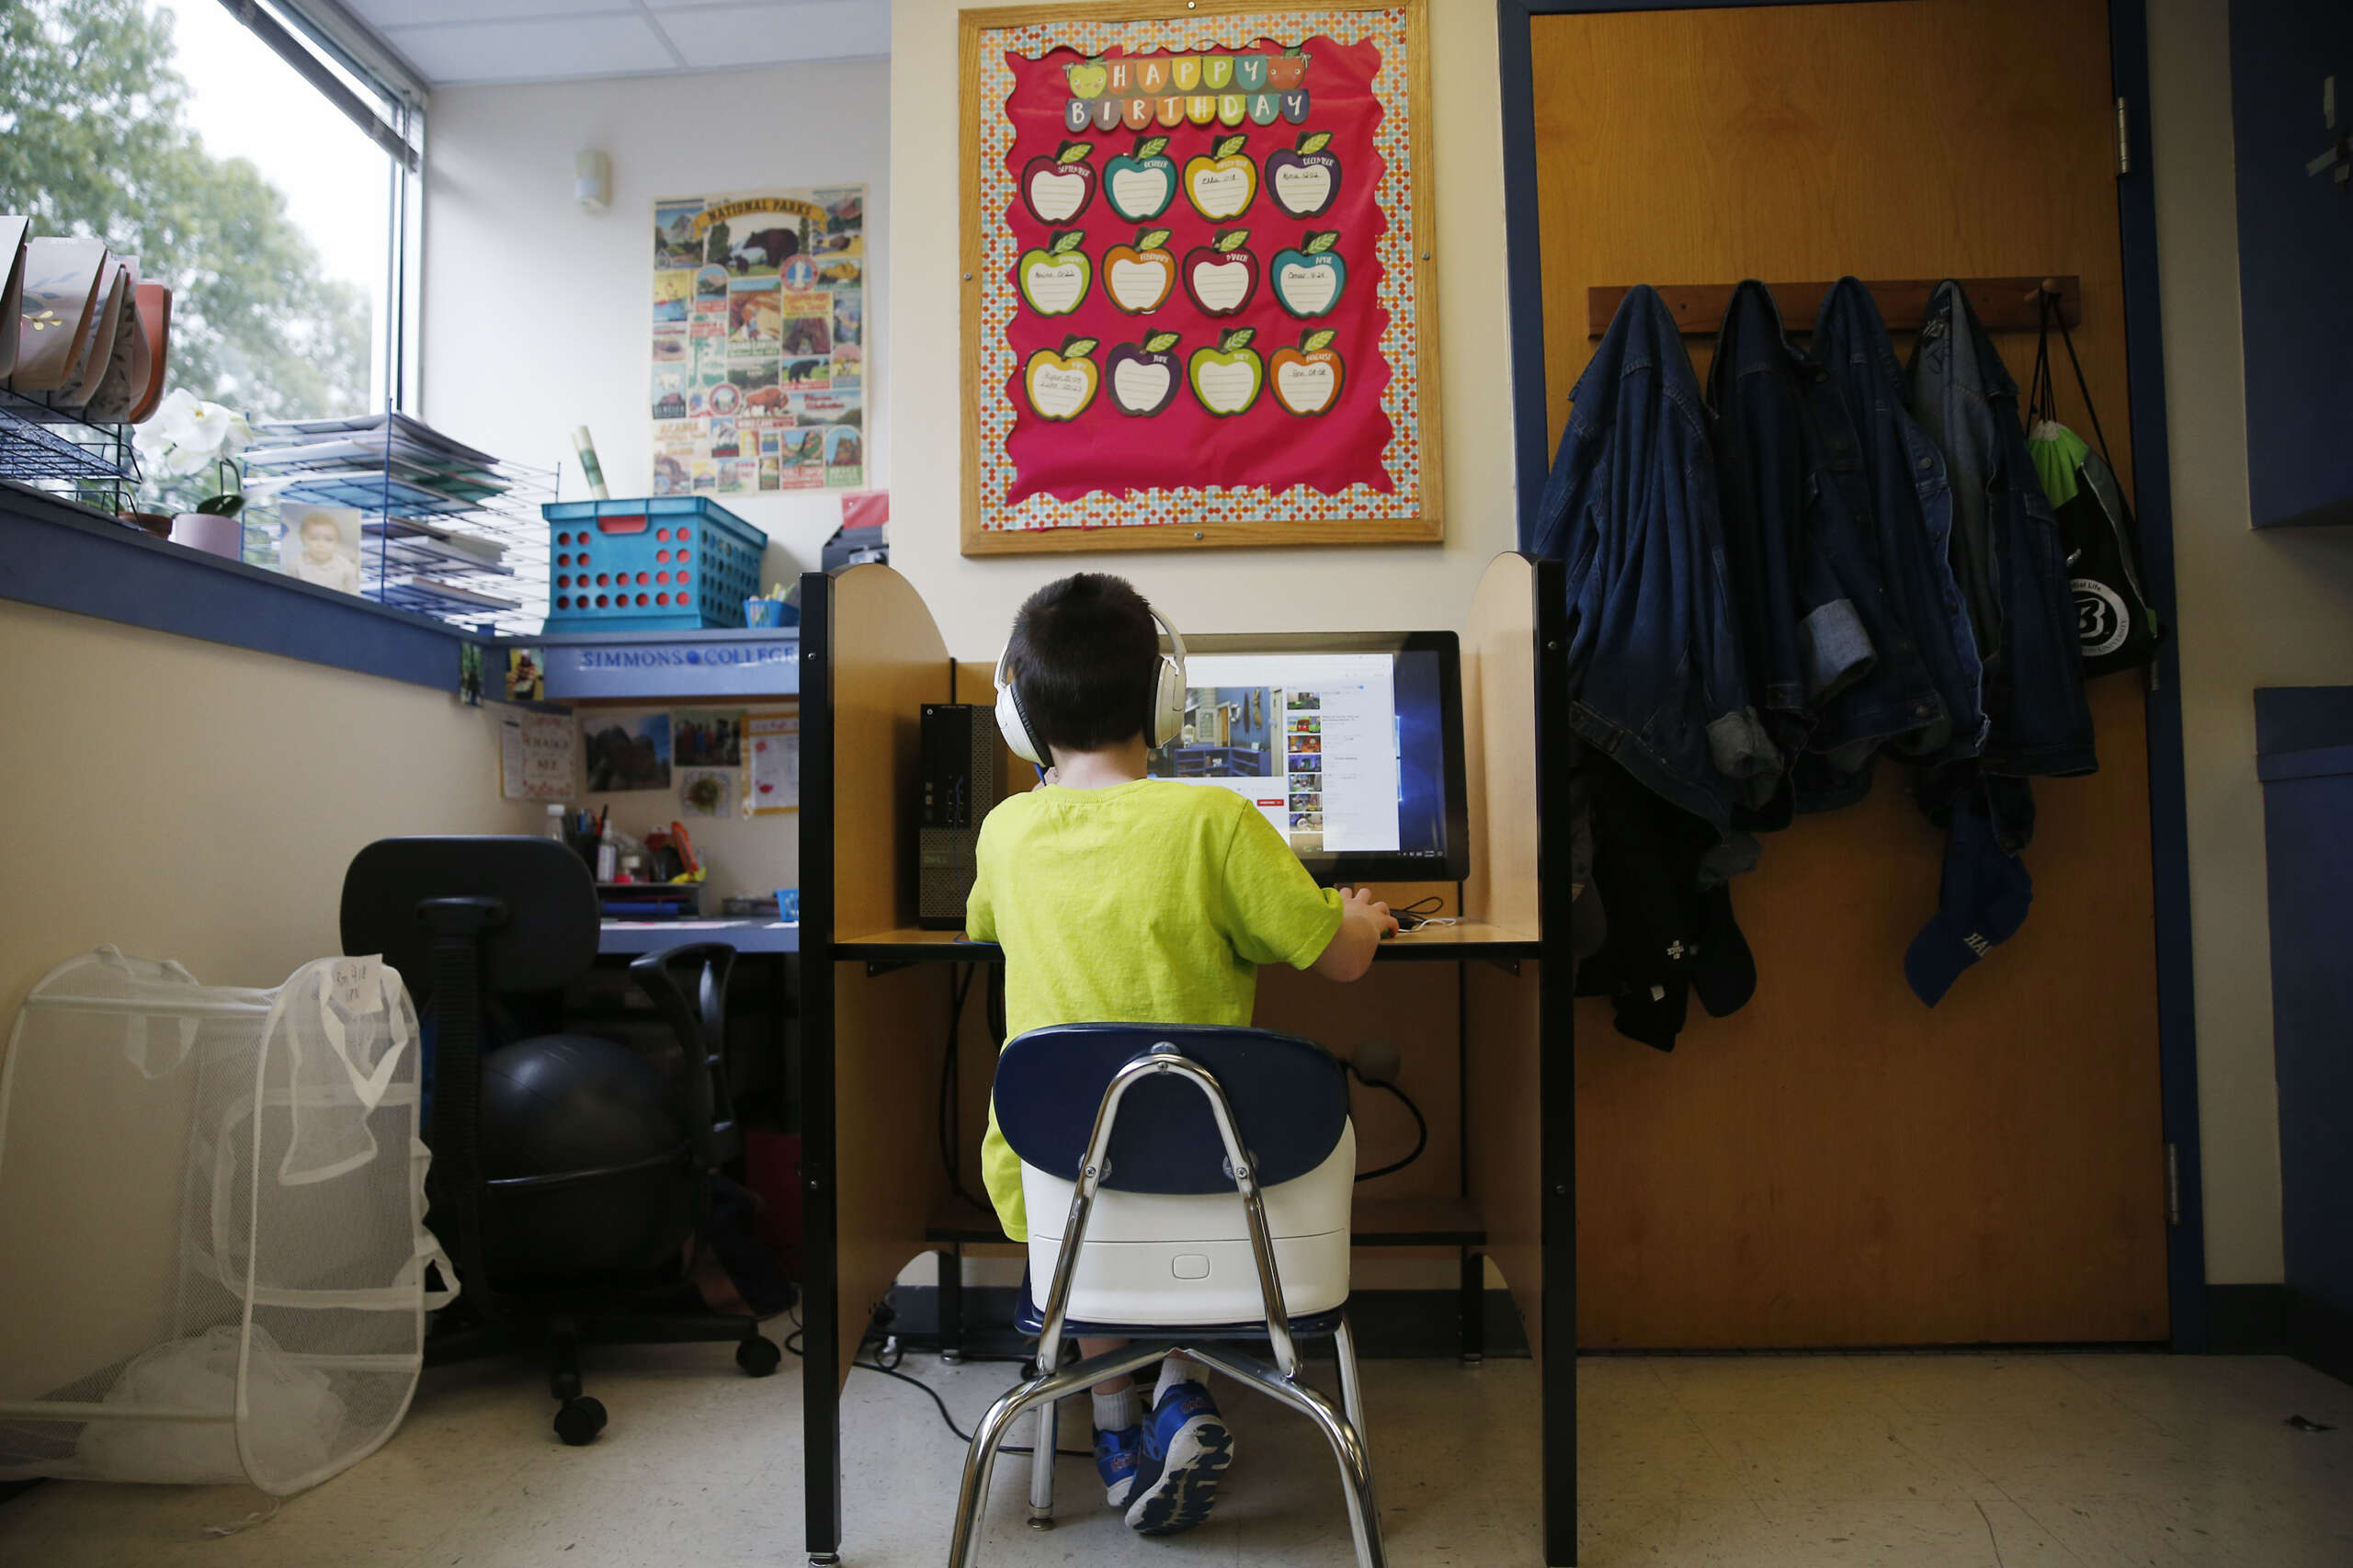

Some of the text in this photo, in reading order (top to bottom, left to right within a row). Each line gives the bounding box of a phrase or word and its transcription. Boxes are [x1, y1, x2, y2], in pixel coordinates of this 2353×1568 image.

[1113, 61, 1259, 87] HAPPY
[1072, 94, 1302, 124] BIRTHDAY
[708, 198, 812, 223] NATIONAL PARKS
[583, 645, 796, 668] SIMMONS COLLEGE
